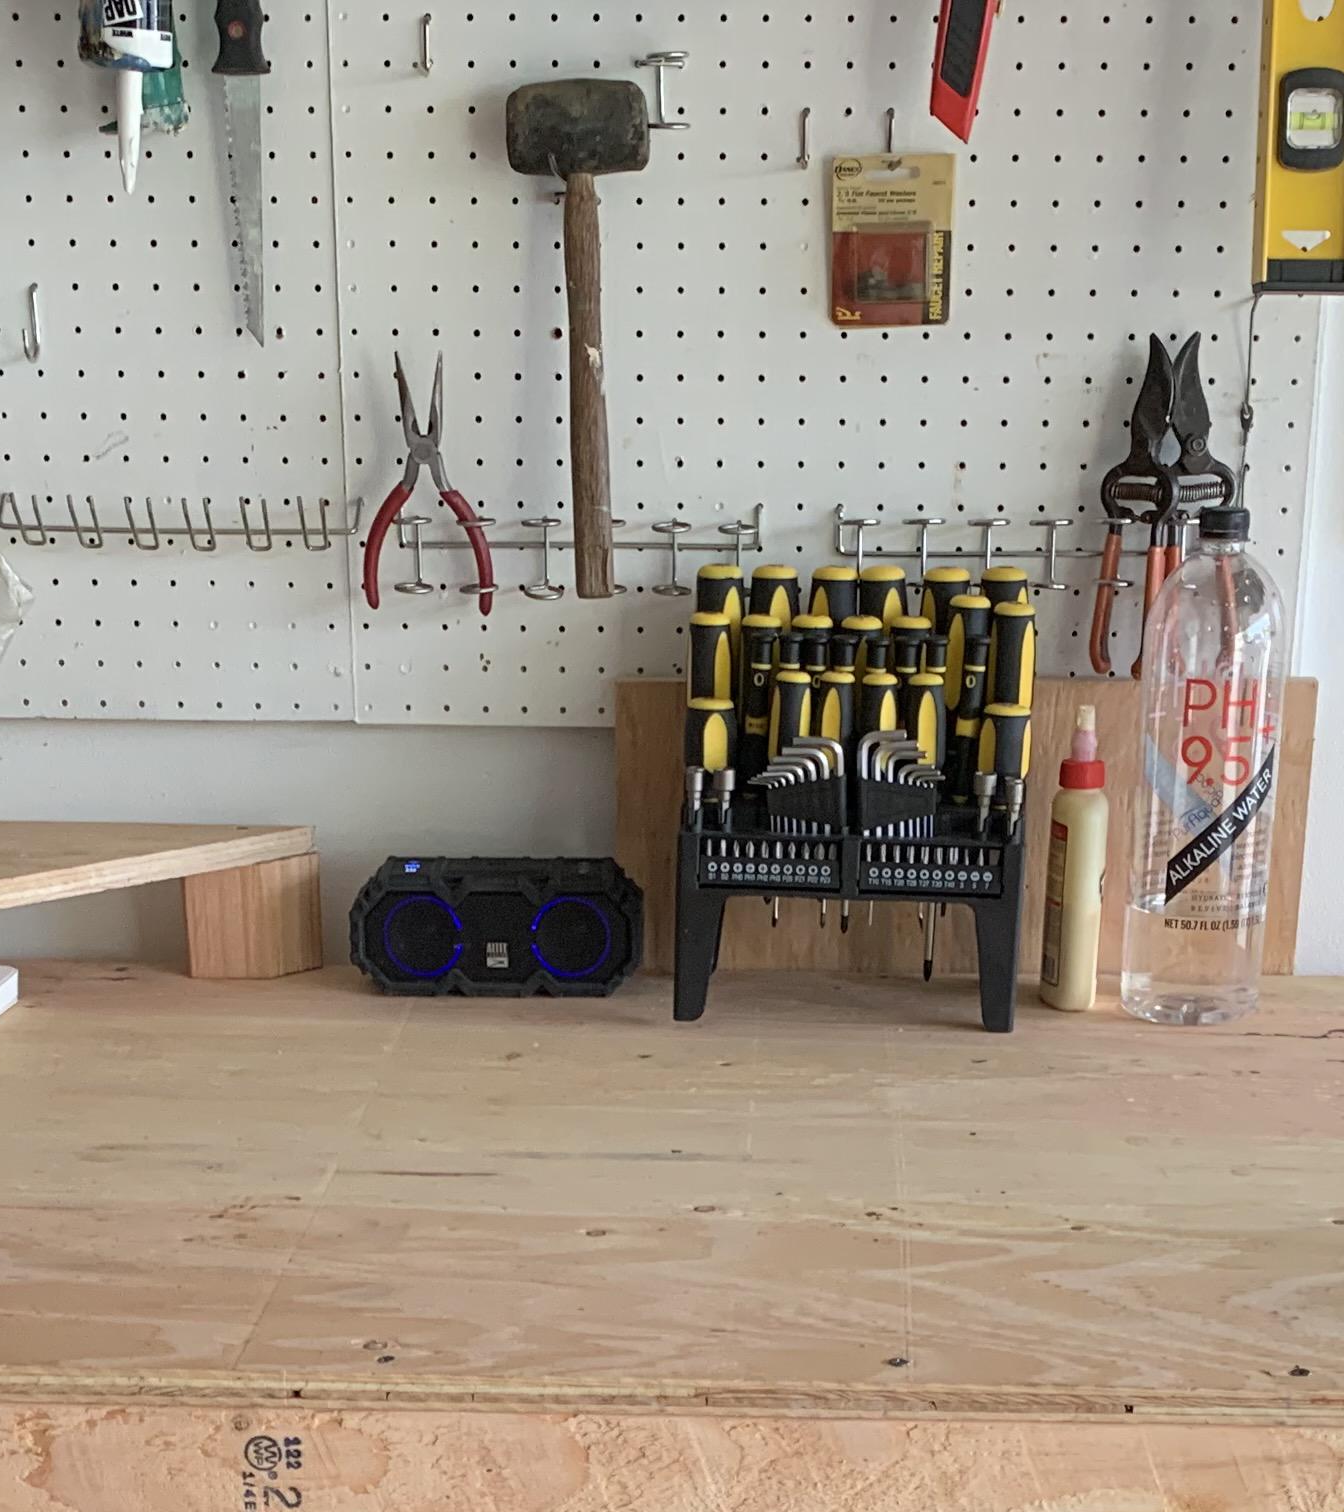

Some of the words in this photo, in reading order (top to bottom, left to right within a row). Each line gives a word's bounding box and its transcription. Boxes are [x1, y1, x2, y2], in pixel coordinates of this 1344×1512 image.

[1183, 678, 1258, 729] PH
[1181, 735, 1251, 786] 9.5
[1167, 818, 1237, 886] ALKALINE
[1232, 767, 1272, 822] WATER
[1164, 918, 1178, 929] NET
[1181, 919, 1198, 930] 50.7
[1199, 920, 1207, 931] FL
[1211, 920, 1221, 930] OZ
[284, 1436, 303, 1470] 122
[263, 1485, 303, 1510] 2
